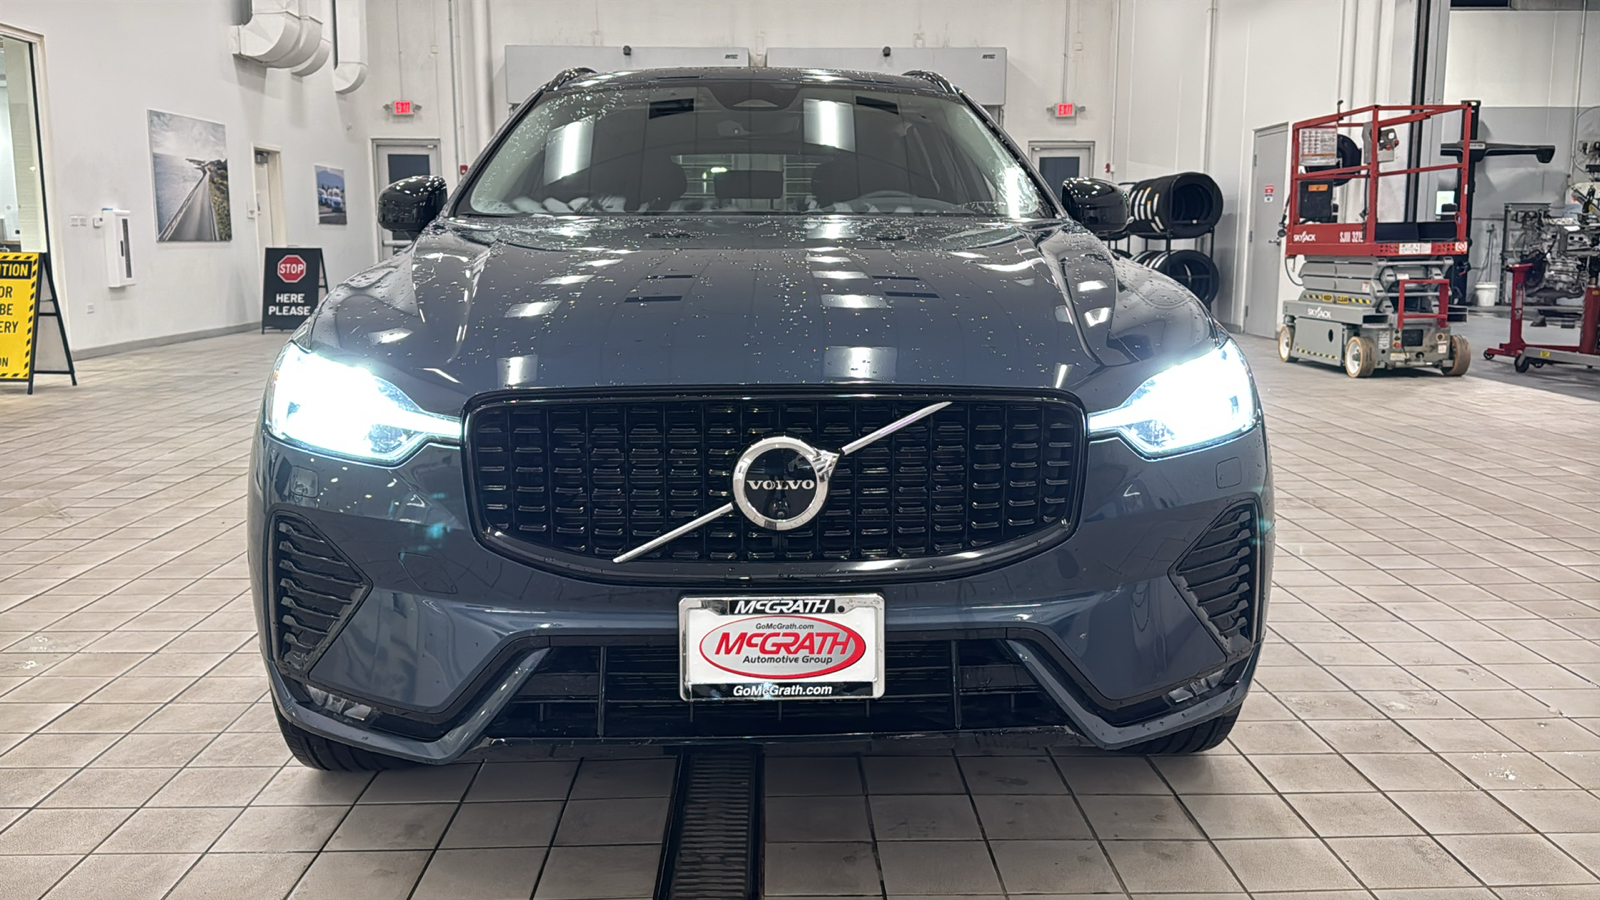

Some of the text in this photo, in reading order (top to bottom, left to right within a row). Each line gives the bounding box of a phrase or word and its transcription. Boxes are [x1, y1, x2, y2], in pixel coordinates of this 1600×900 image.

[0, 263, 29, 277] TION
[279, 263, 304, 274] STOP
[275, 293, 305, 304] HERE
[268, 305, 312, 316] PLEASE
[746, 479, 815, 490] VOLVO
[755, 622, 814, 630] GoMcGrath.com
[742, 655, 833, 666] Automotive Group
[733, 684, 833, 697] GoMcGrath.com
